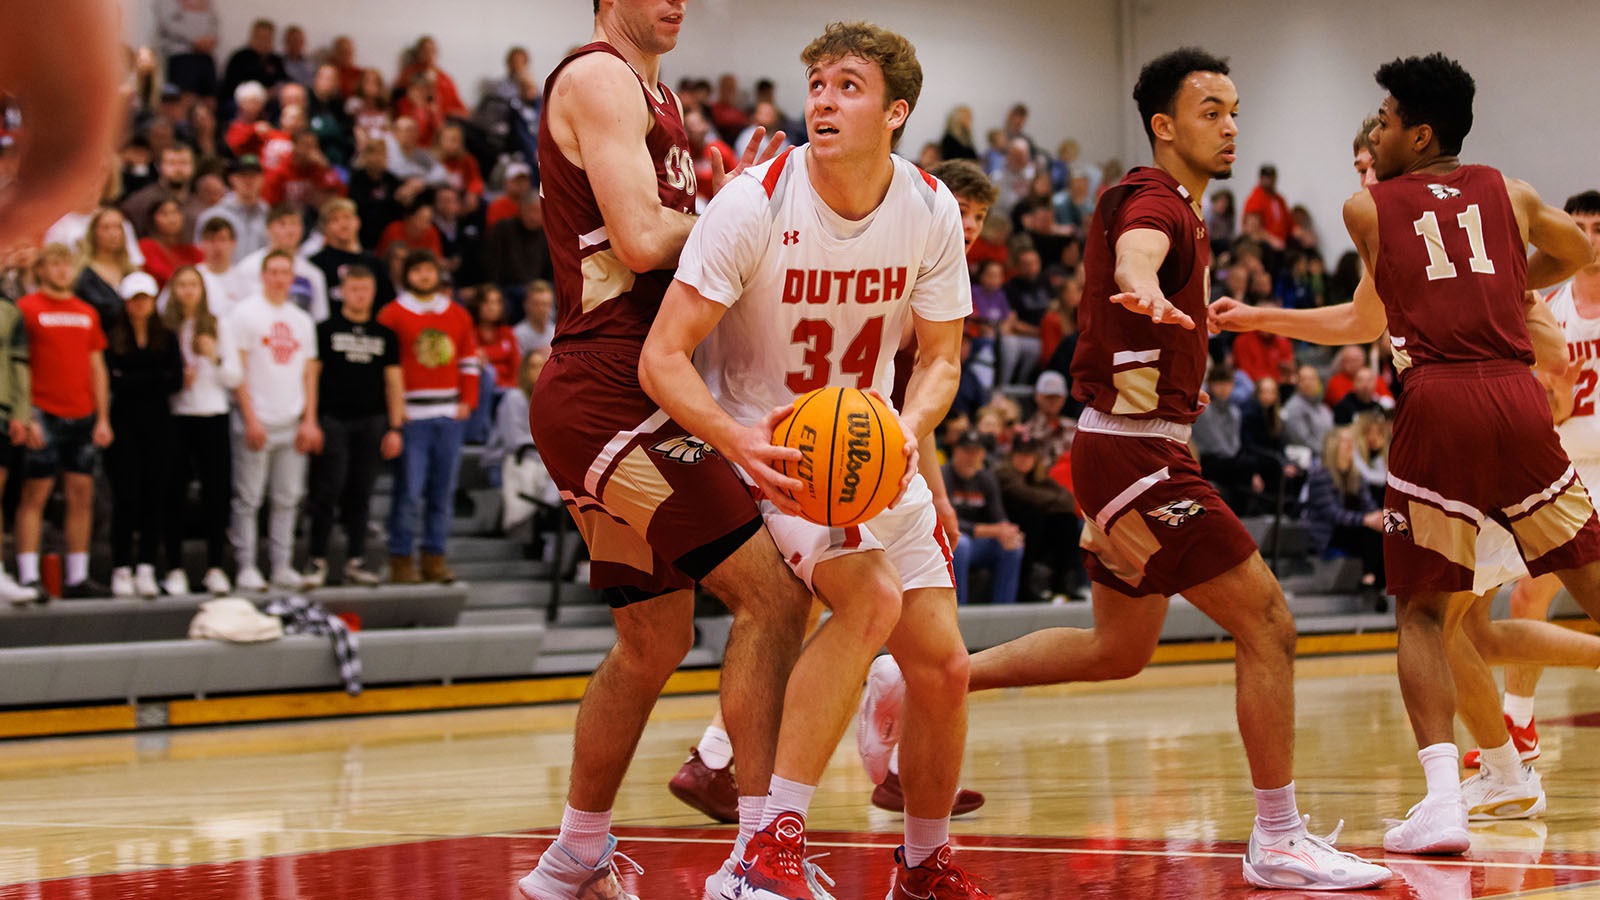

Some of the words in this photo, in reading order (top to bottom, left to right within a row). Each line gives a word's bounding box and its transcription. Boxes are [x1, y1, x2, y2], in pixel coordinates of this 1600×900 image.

[1413, 204, 1495, 281] 11
[782, 267, 907, 305] DUTCH
[784, 313, 885, 395] 34
[798, 425, 817, 482] EVO
[839, 411, 871, 504] Wilson
